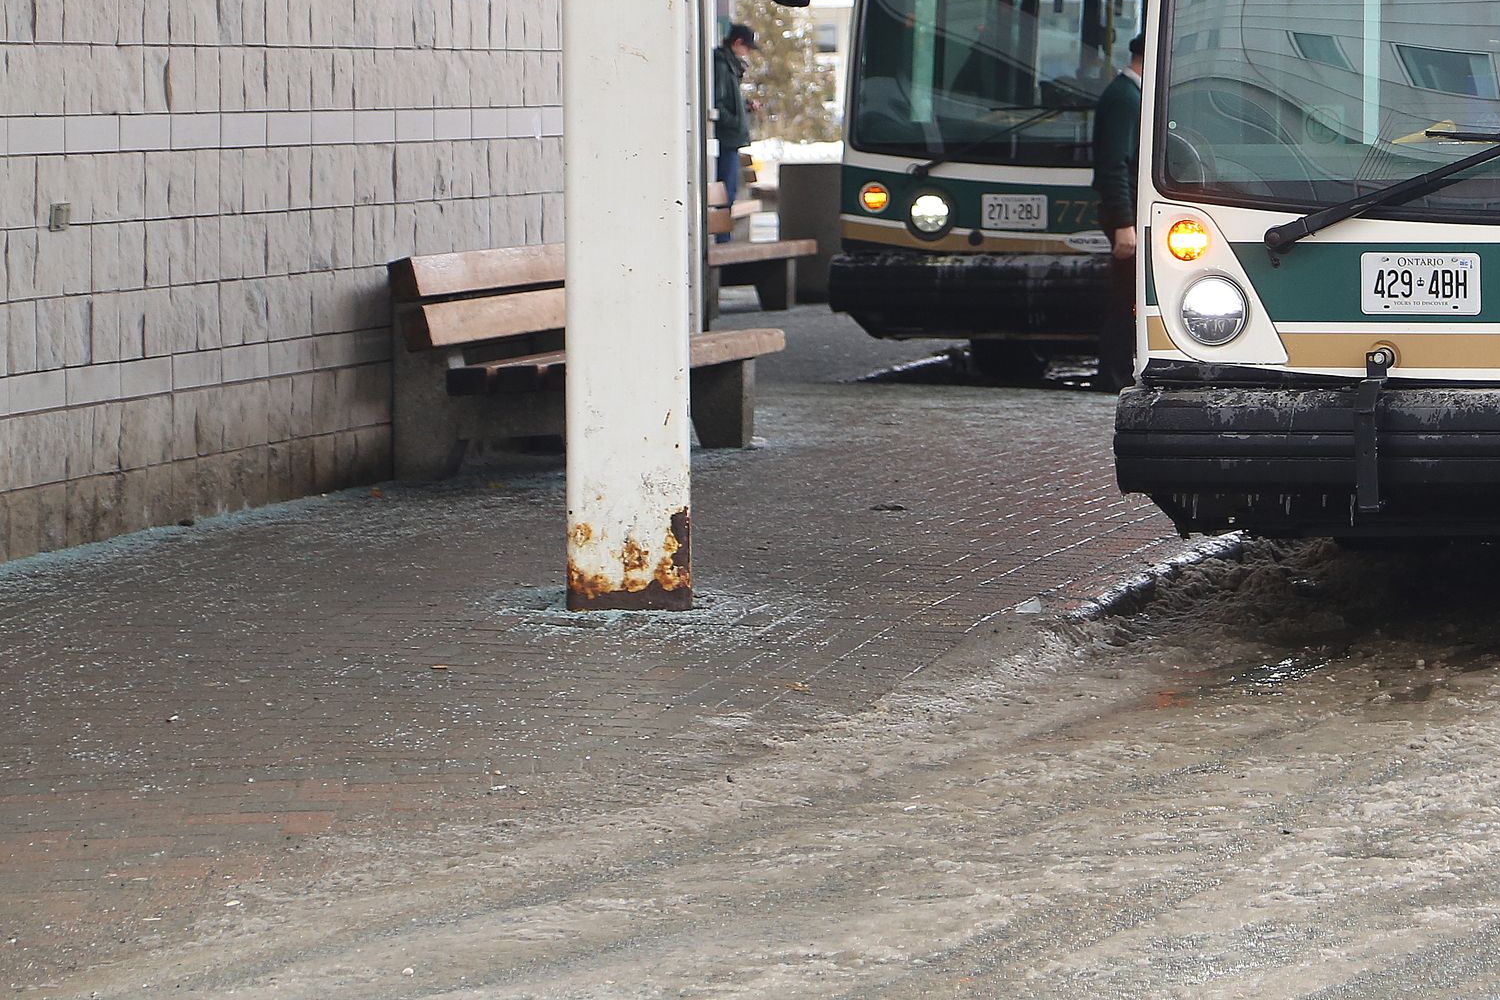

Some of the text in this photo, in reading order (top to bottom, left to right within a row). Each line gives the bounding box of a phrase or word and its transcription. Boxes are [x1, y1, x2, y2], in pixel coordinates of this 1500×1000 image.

[988, 203, 1009, 220] 271
[1397, 256, 1444, 267] ONTARIO
[1373, 269, 1468, 299] 429 4BH
